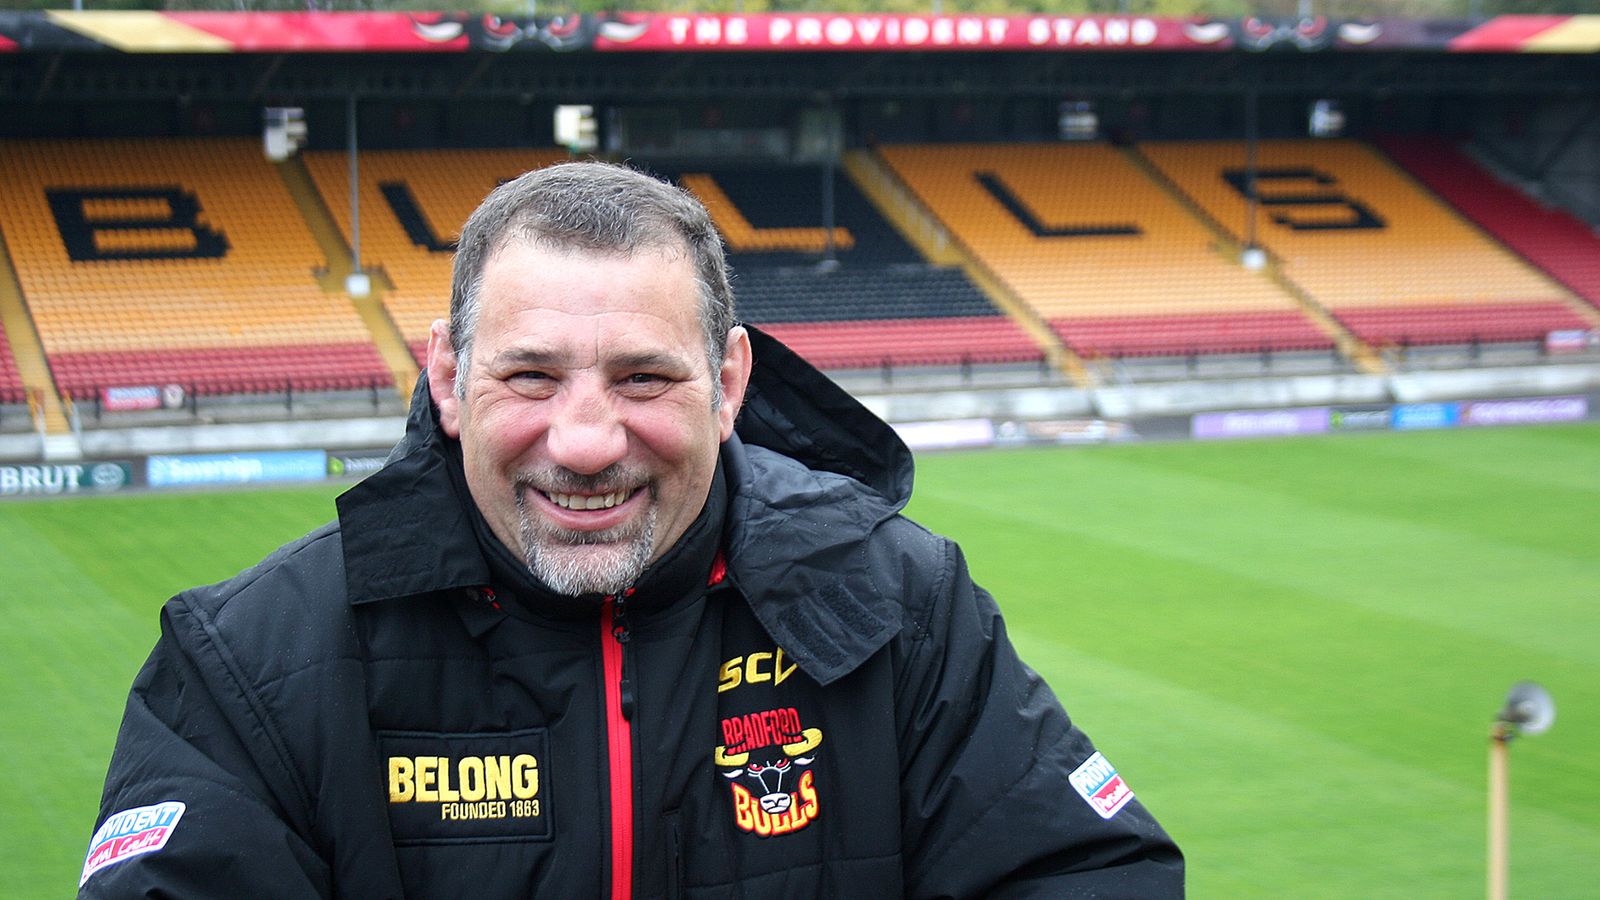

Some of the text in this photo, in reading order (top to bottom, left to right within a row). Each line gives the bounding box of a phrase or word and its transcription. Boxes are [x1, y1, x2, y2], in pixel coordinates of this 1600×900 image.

[667, 17, 1158, 46] THE PROVIDENT STAND
[0, 464, 84, 494] BRUT
[721, 707, 803, 755] BRADFORD
[388, 754, 539, 802] BELONG
[441, 799, 540, 821] FOUNDED 1863
[731, 769, 821, 837] BULLS
